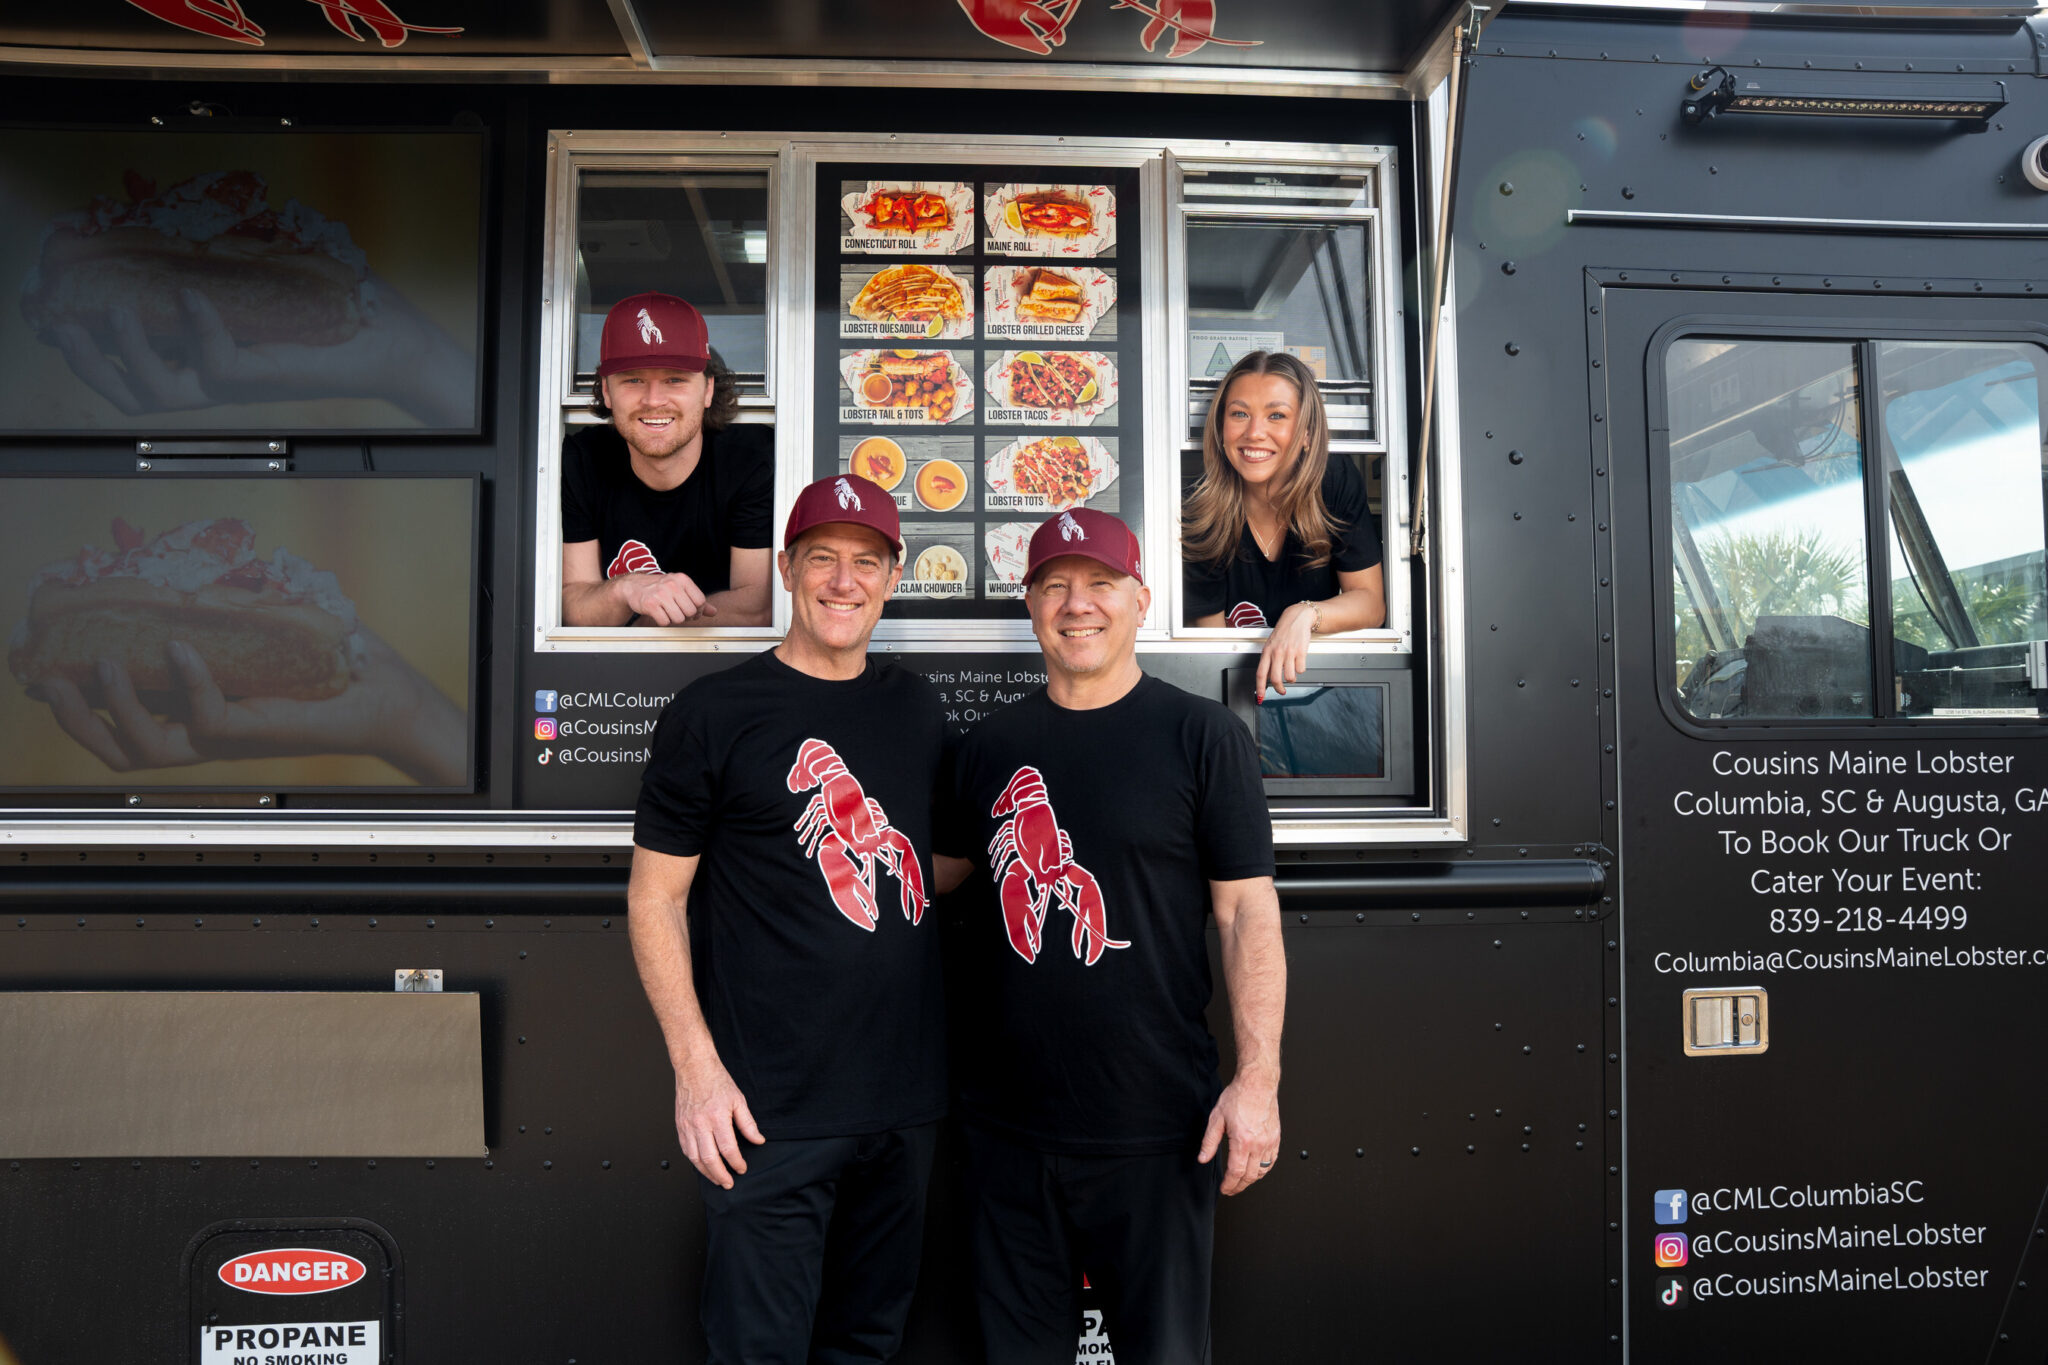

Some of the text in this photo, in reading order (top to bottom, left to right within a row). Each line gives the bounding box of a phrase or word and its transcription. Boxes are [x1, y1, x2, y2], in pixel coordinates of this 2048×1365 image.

[844, 238, 897, 249] CONNECTICUT
[898, 239, 918, 250] ROLL
[987, 242, 1033, 252] MAINE ROLL
[844, 324, 926, 334] LOBSTER QUESADILLA
[987, 325, 1085, 336] LOBSTER GRILLED CHEESE
[843, 409, 924, 420] LOBSTER TAIL & TOTS
[988, 410, 1048, 420] LOBSTER TACOS
[988, 496, 1044, 506] LOBSTER TOTS
[900, 583, 922, 593] CLAM
[924, 583, 962, 593] CHOWDER
[989, 583, 1024, 593] WHOOPIE
[960, 670, 1002, 683] Maine
[956, 690, 974, 702] SC
[980, 690, 989, 702] &
[1713, 750, 2014, 775] Cousins Maine Lobster
[1674, 791, 1810, 816] Columbia,
[1822, 790, 1856, 813] SC
[1867, 789, 1884, 813] &
[1894, 790, 2005, 818] Augusta,
[1718, 827, 2011, 854] To Book Our Truck Or
[1751, 868, 1980, 893] Cater Your Event:
[1770, 906, 1966, 933] 839-218-4499
[1655, 946, 2048, 973] Columbia@CousinsMaineLobster.c
[1692, 1181, 1923, 1215] @CMLColumbiaSC
[1693, 1223, 1986, 1257] @CousinsMaineLobster
[235, 1262, 349, 1283] DANGER
[1693, 1266, 1988, 1300] @CousinsMaineLobster
[215, 1325, 366, 1351] PROPANE
[233, 1353, 348, 1365] NO SMOKING
